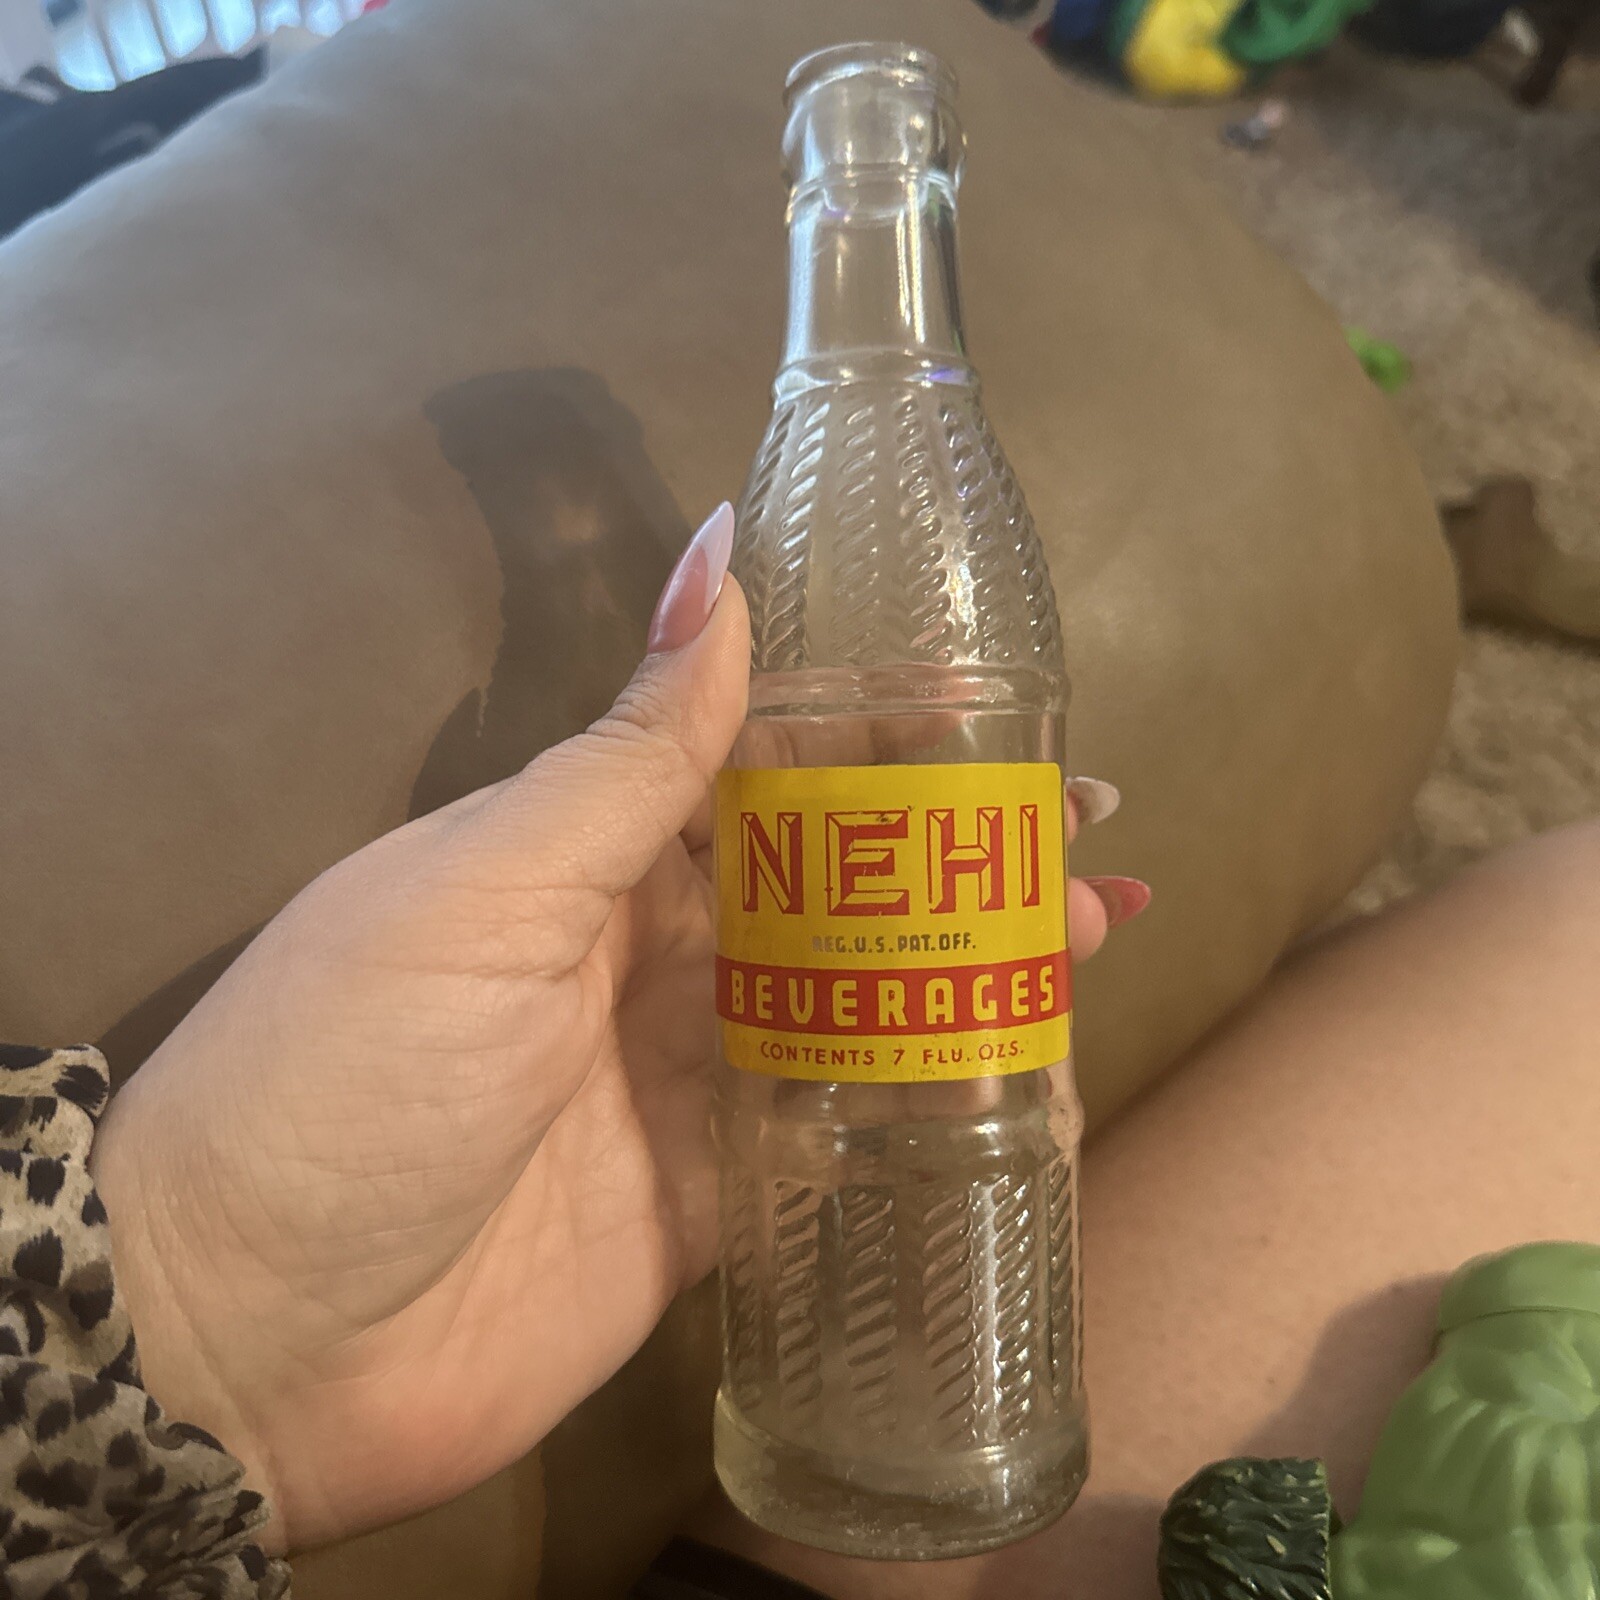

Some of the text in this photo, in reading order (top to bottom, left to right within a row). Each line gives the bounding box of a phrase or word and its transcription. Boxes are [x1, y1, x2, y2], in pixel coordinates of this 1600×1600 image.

[740, 804, 1040, 917] NEHI
[731, 964, 1054, 1028] BEVERAGES
[760, 1040, 875, 1066] CONTENTS
[893, 1049, 905, 1066] 7
[978, 1040, 1024, 1062] OZS.
